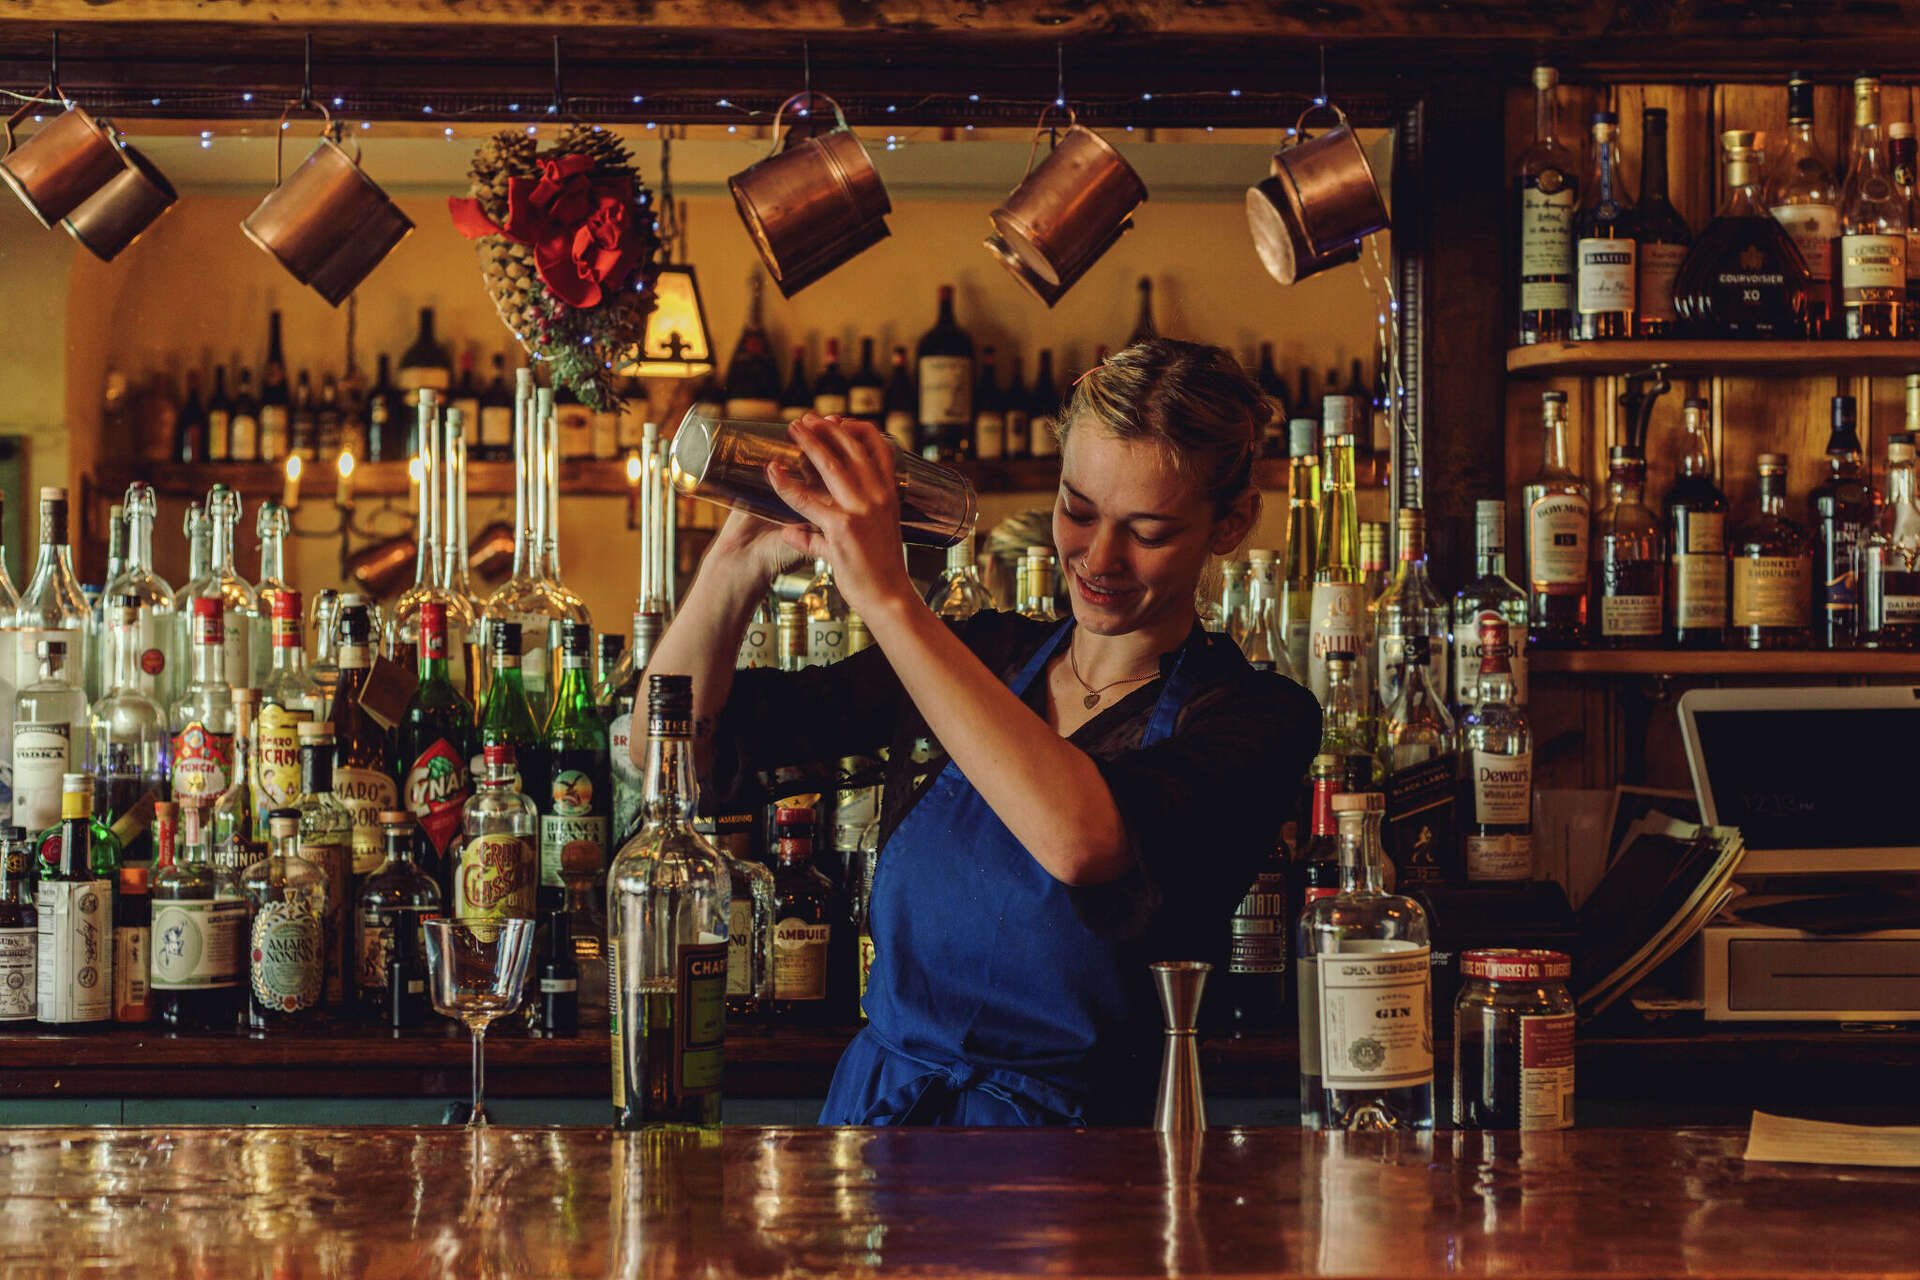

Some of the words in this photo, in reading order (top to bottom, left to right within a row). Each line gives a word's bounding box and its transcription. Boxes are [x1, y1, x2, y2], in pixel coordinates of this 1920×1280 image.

[1719, 274, 1784, 284] COURVOISIER
[1743, 290, 1761, 301] XO
[1752, 560, 1798, 568] MONKEY
[546, 822, 600, 832] BRANCA
[213, 852, 266, 866] VECINOS
[777, 928, 827, 941] AMBUIE
[1474, 961, 1489, 975] CITY
[1490, 962, 1527, 977] WHISKEY
[1375, 1007, 1412, 1019] GIN
